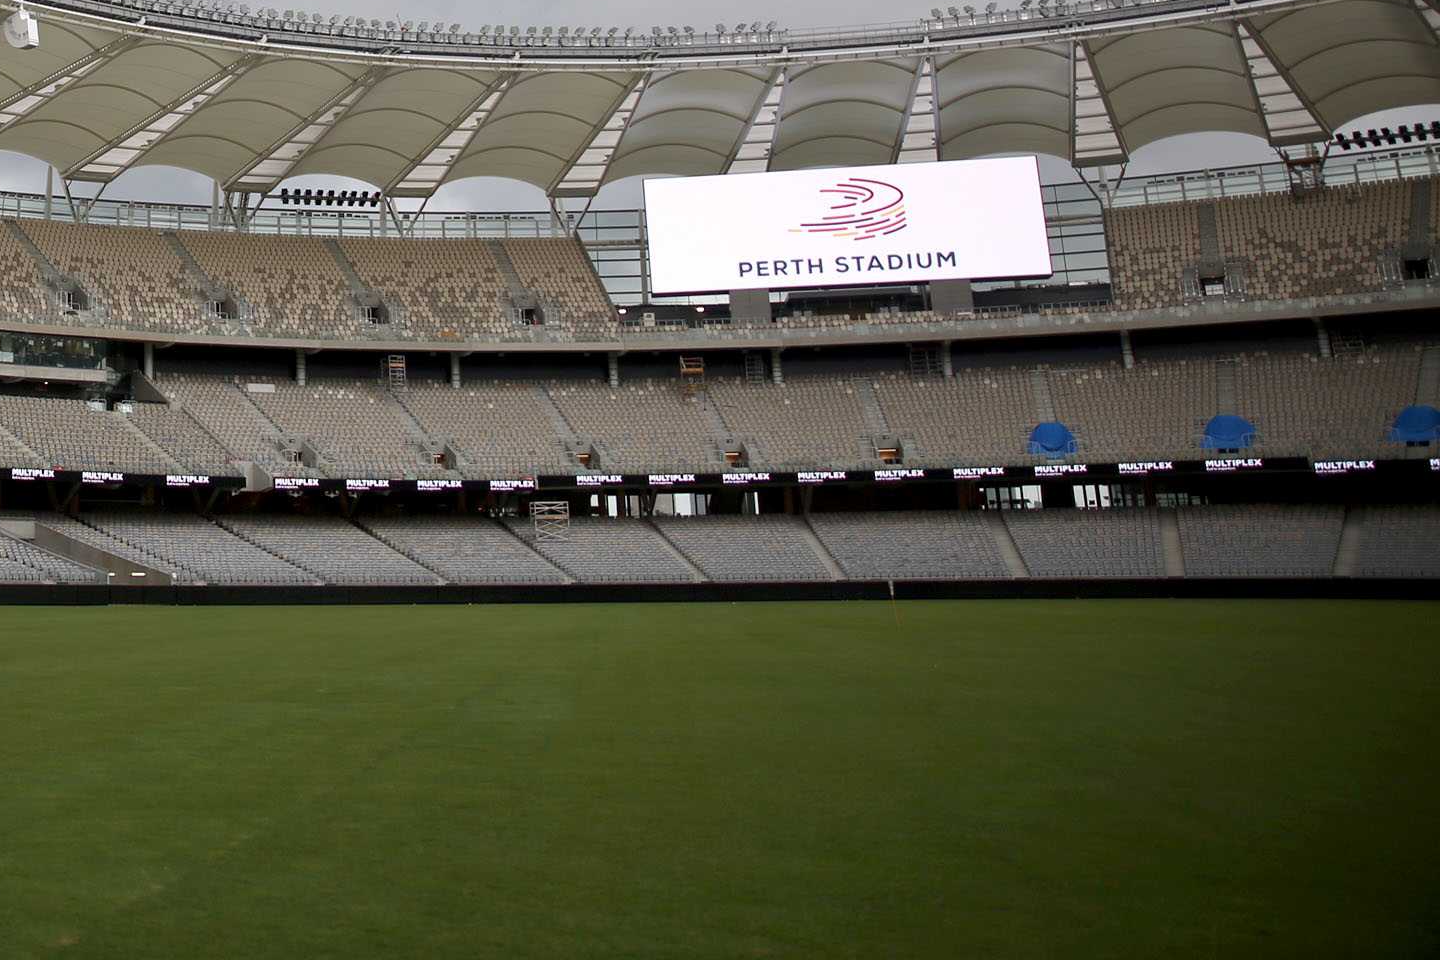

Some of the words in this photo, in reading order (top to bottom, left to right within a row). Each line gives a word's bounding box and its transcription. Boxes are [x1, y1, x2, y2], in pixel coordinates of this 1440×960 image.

[739, 258, 823, 277] PERTH
[835, 251, 957, 273] STADIUM
[1118, 461, 1173, 471] MULTIPLEX
[1205, 458, 1262, 468] MULTIPLEX
[1314, 460, 1375, 470] MULTIPLEX
[11, 468, 55, 478] MULTIPLEX
[874, 469, 924, 478] MULTIPLEX
[953, 467, 1004, 476] MULTIPLEX
[1034, 464, 1087, 474] MULTIPLEX
[82, 471, 124, 481] MULTIPLEX
[166, 474, 210, 483] MULTIPLEX
[576, 474, 623, 483] MULTIPLEX
[648, 473, 695, 482] MULTIPLEX
[722, 472, 770, 481] MULTIPLEX
[797, 471, 846, 480] MULTIPLEX
[274, 478, 319, 487] MULTIPLEX
[346, 479, 390, 488] MULTIPLEX
[417, 479, 462, 488] MULTIPLEX
[489, 480, 534, 488] MULTIPLEX
